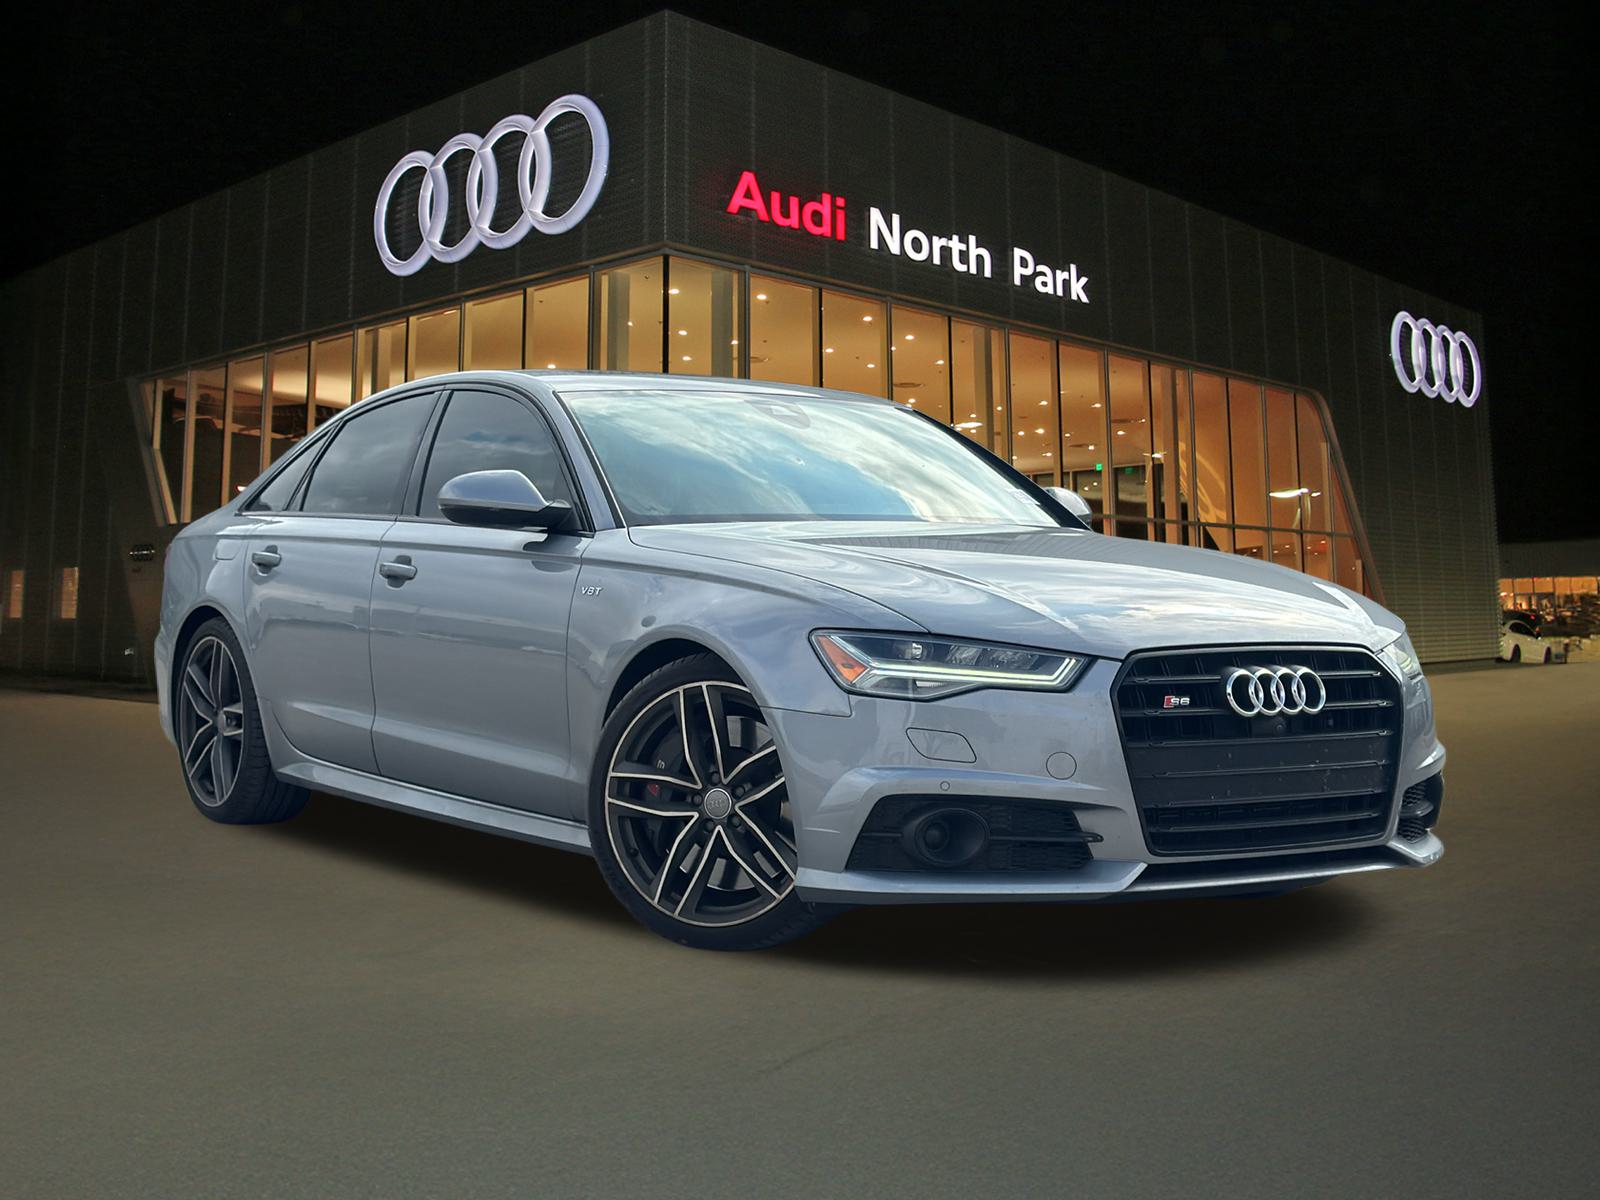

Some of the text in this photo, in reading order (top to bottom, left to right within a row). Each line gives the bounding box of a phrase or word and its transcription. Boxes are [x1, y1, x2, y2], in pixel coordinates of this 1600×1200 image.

[726, 170, 1090, 304] Audi North Park
[1170, 697, 1190, 706] S6
